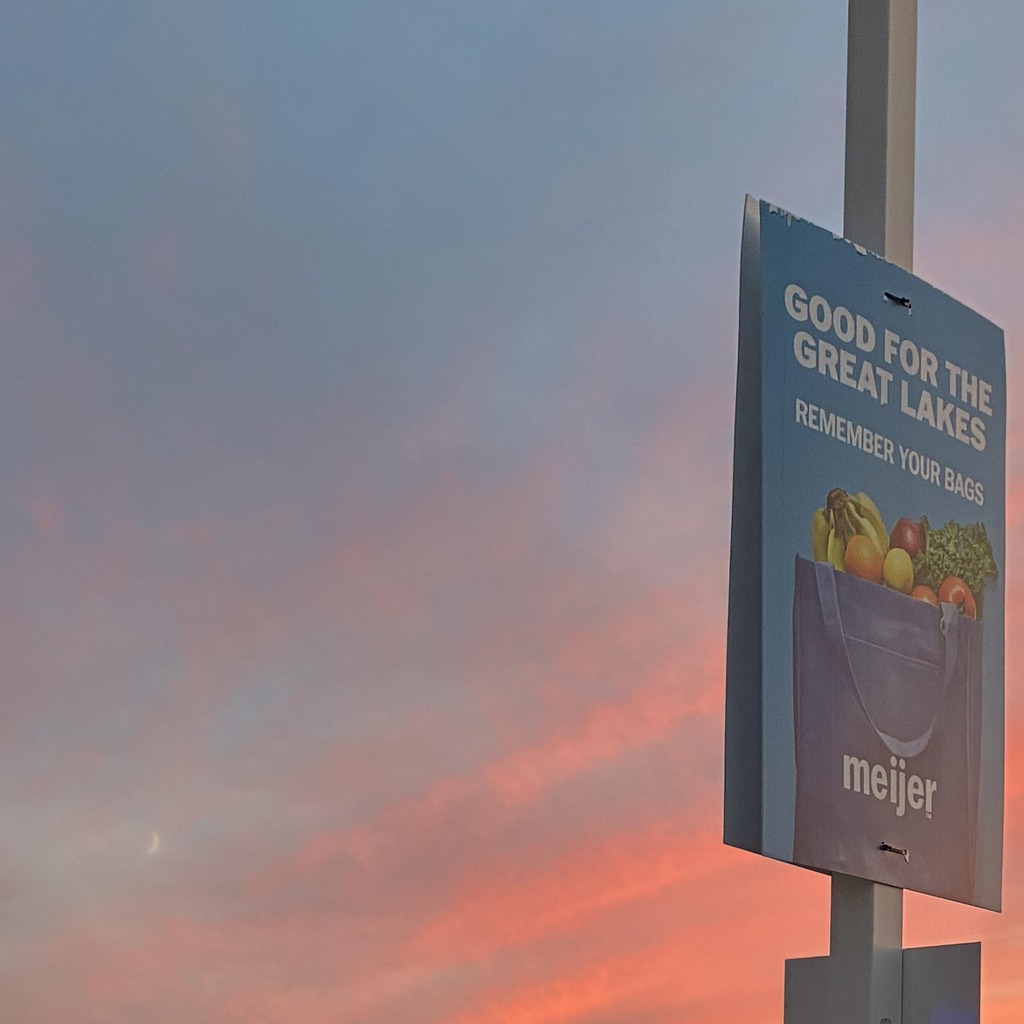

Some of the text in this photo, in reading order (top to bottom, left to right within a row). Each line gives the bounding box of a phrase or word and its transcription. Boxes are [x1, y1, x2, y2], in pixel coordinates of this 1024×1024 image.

[784, 284, 993, 417] GOOD FOR THE
[793, 331, 986, 452] GREAT LAKES
[795, 398, 984, 506] REMEMBER YOUR BAGS
[843, 754, 938, 819] meijer
